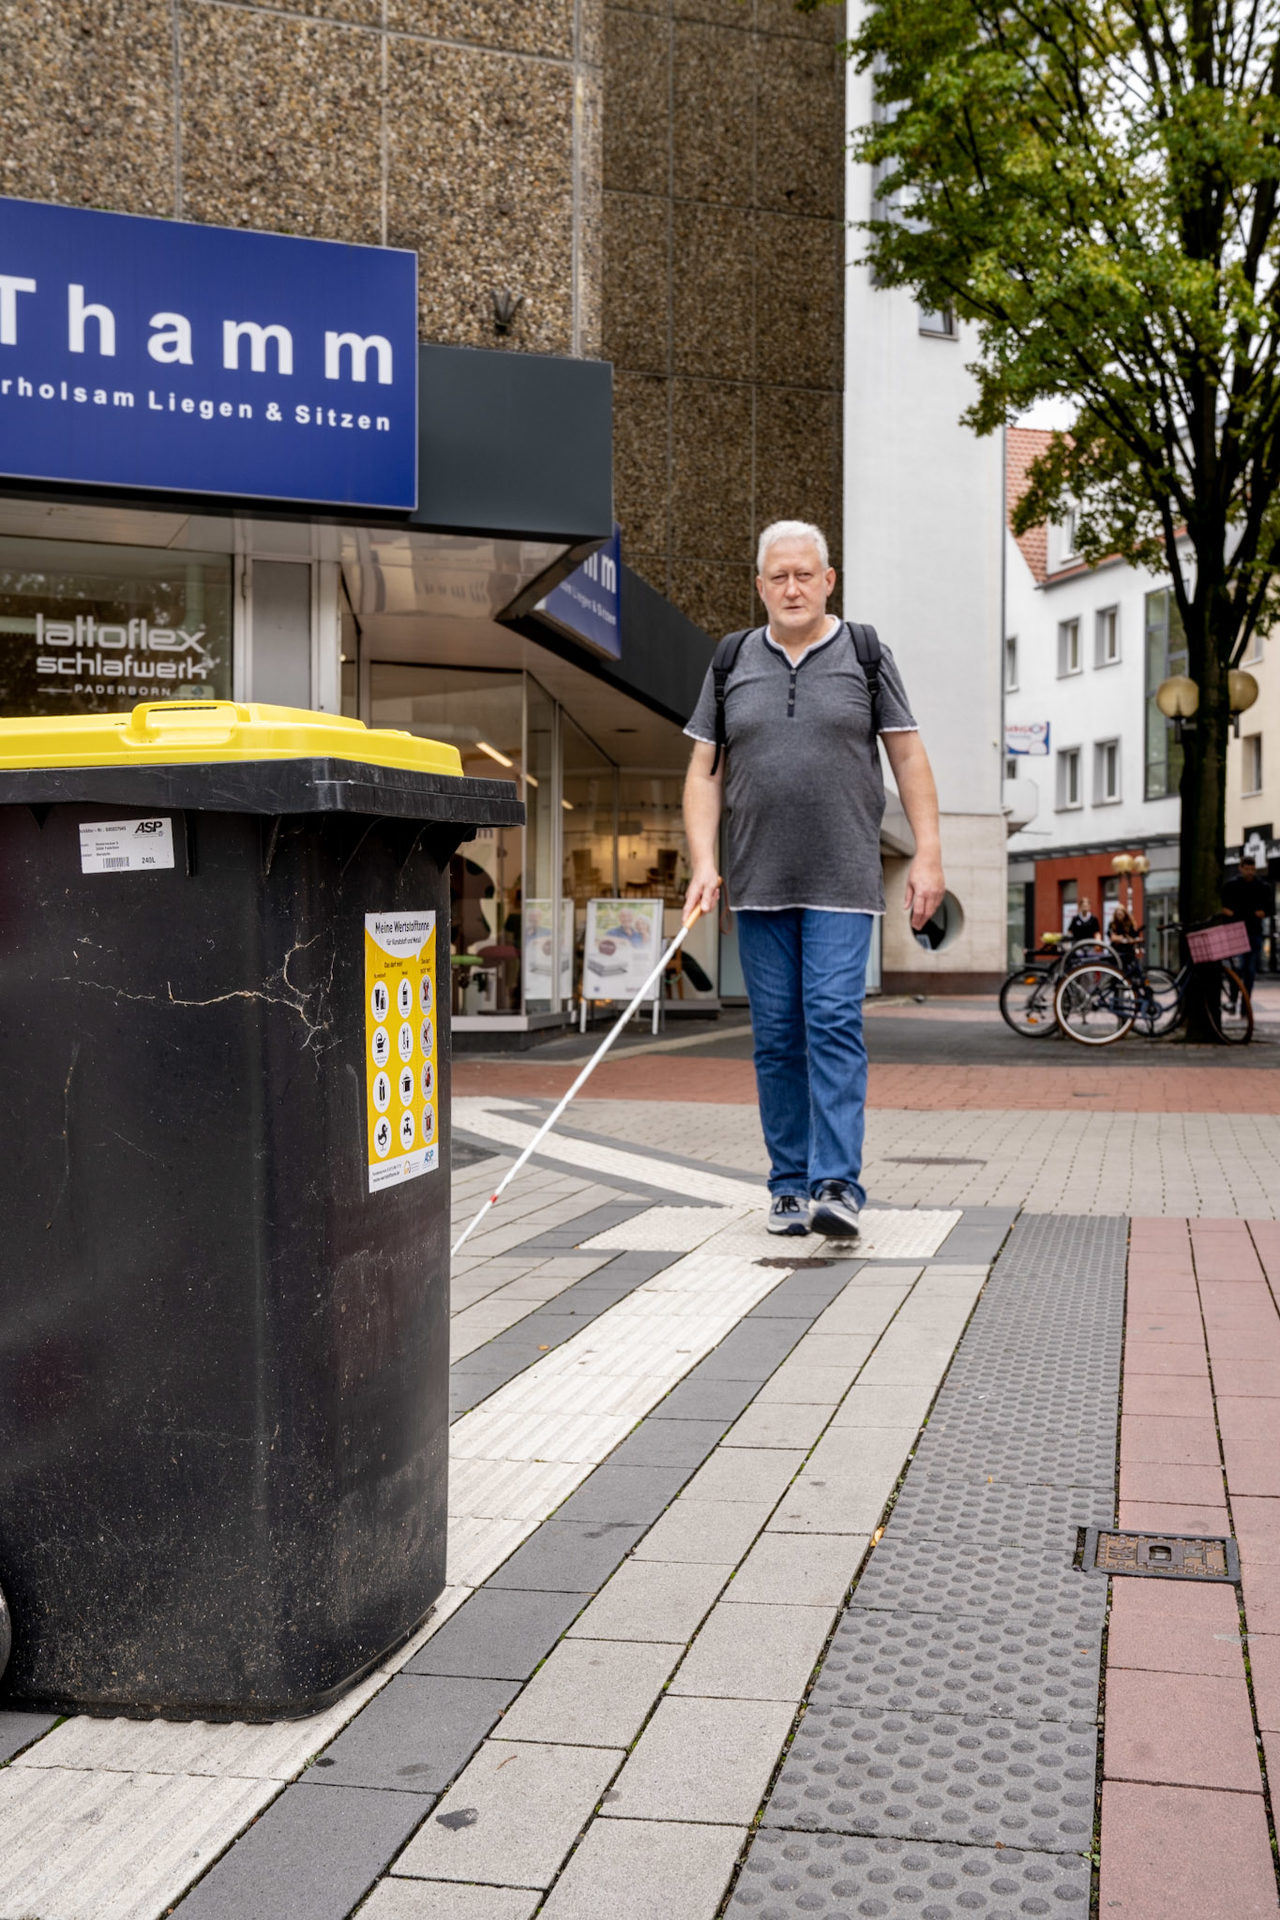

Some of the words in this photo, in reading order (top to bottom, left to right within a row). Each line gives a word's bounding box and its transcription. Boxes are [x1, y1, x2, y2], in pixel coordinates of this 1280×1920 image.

[0, 273, 393, 385] Thamm
[148, 390, 252, 419] Liegen
[266, 402, 282, 421] &
[295, 405, 390, 431] Sitzen
[36, 613, 206, 653] lattoflex
[36, 652, 207, 679] schlafwerk
[74, 683, 171, 697] PADERBORN
[135, 821, 163, 834] ASP
[375, 920, 393, 934] Meine
